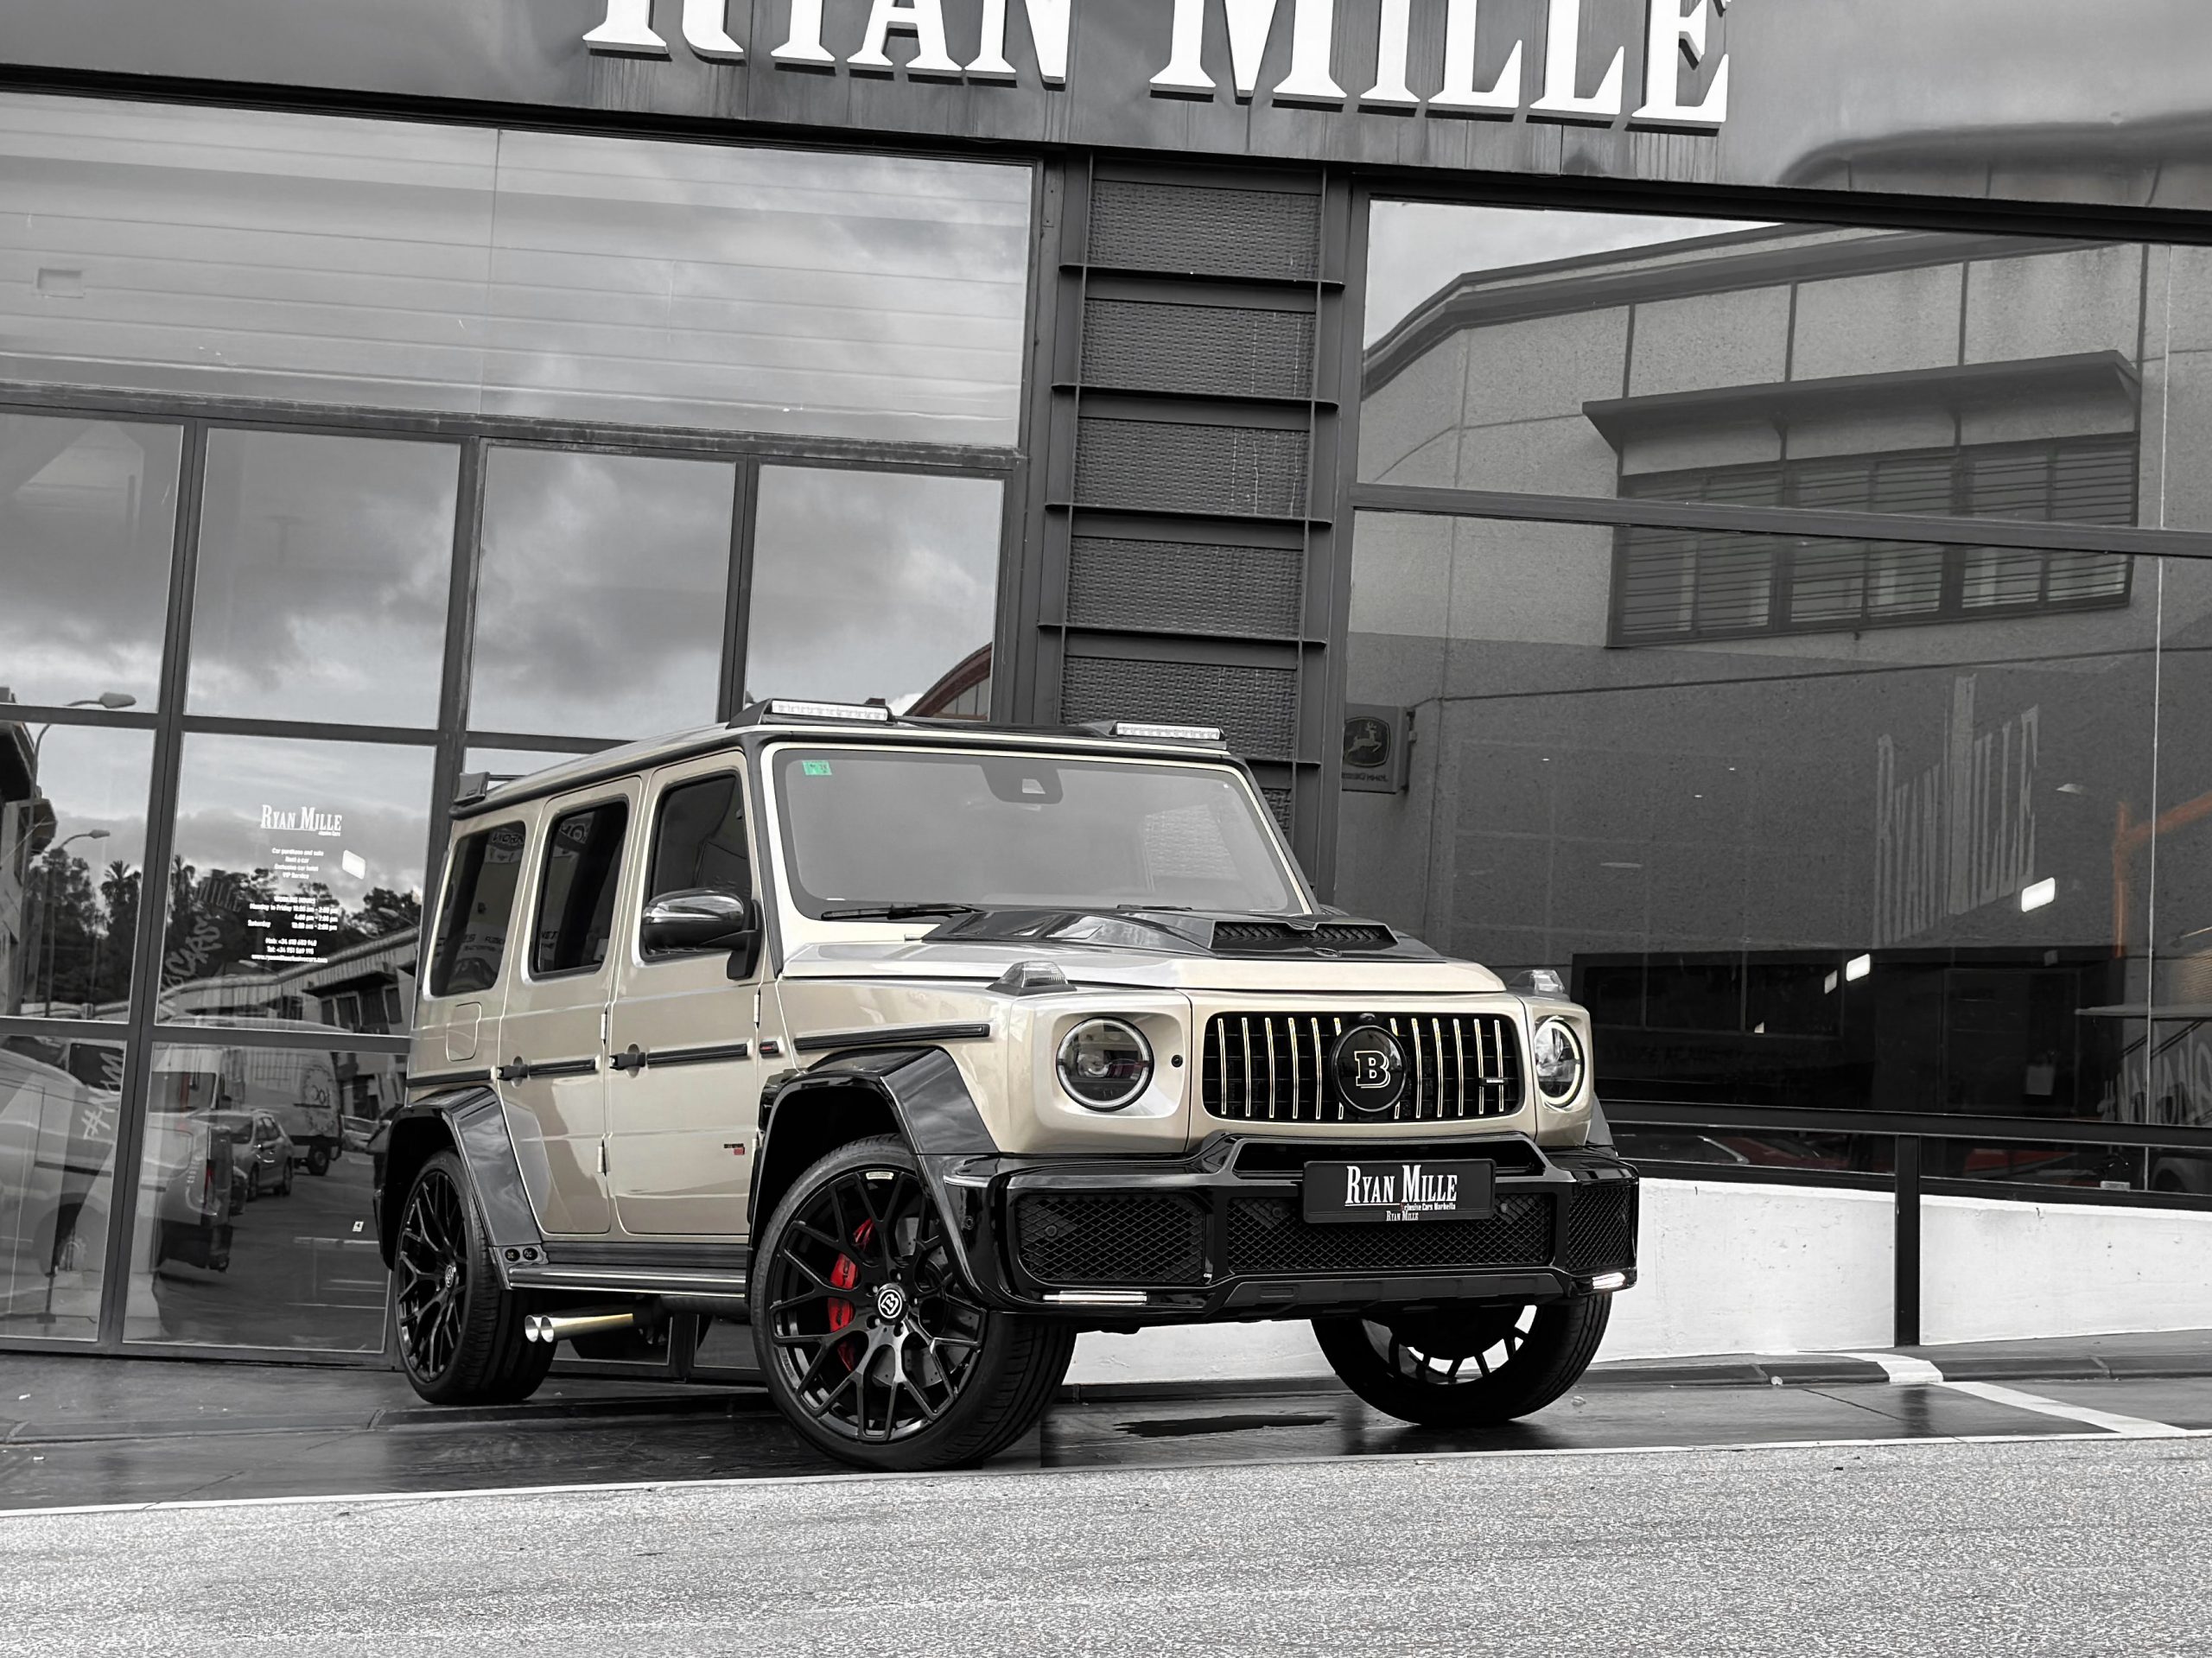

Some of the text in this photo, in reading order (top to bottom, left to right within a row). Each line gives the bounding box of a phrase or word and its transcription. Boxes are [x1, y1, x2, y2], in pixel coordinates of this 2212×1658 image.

[260, 804, 342, 831] RYAN MILLE
[248, 919, 271, 928] Saturday
[1344, 1165, 1459, 1204] RYAN MILLE
[1386, 1210, 1419, 1222] RYAN MILLE
